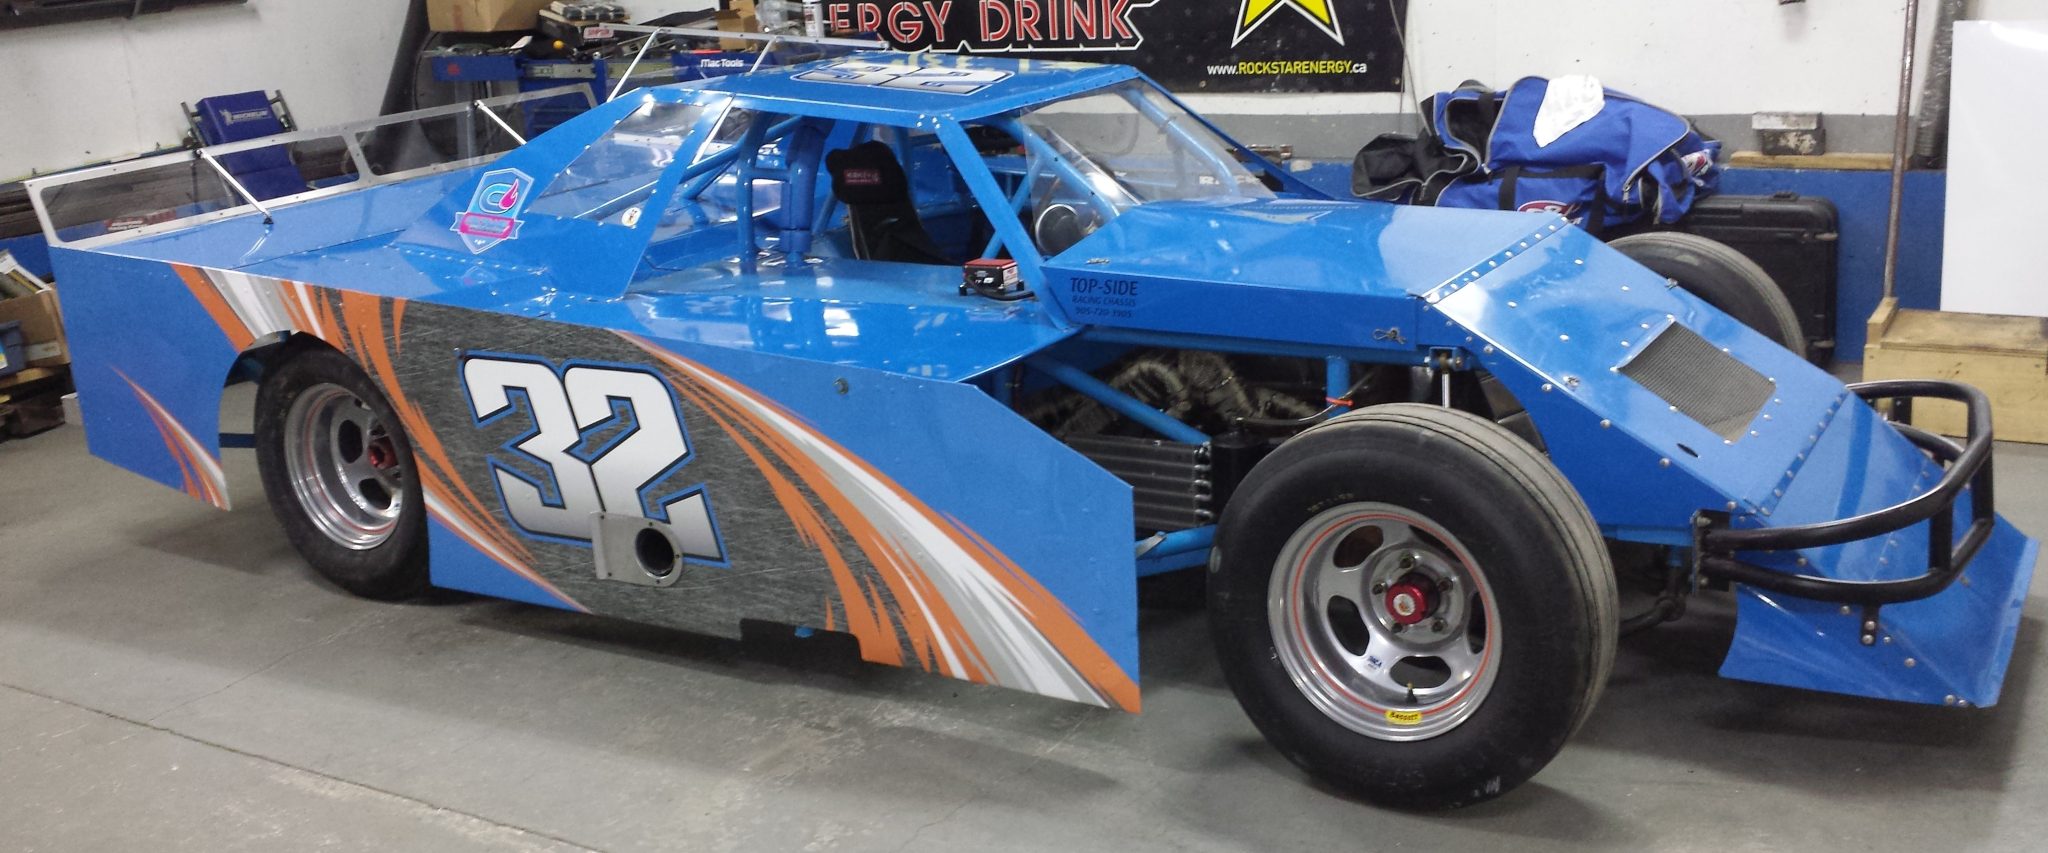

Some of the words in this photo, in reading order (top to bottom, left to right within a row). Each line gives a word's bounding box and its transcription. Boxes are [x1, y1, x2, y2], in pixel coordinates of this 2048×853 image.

[979, 0, 1133, 42] DRINK
[700, 58, 720, 68] Mac
[721, 58, 744, 68] Tools
[1207, 60, 1368, 75] www.ROCKSTARENERGY.ca
[1070, 277, 1139, 296] TOP-SIDE
[1072, 295, 1102, 305] RACING
[1103, 296, 1137, 307] CHASSIS
[456, 350, 732, 568] 32
